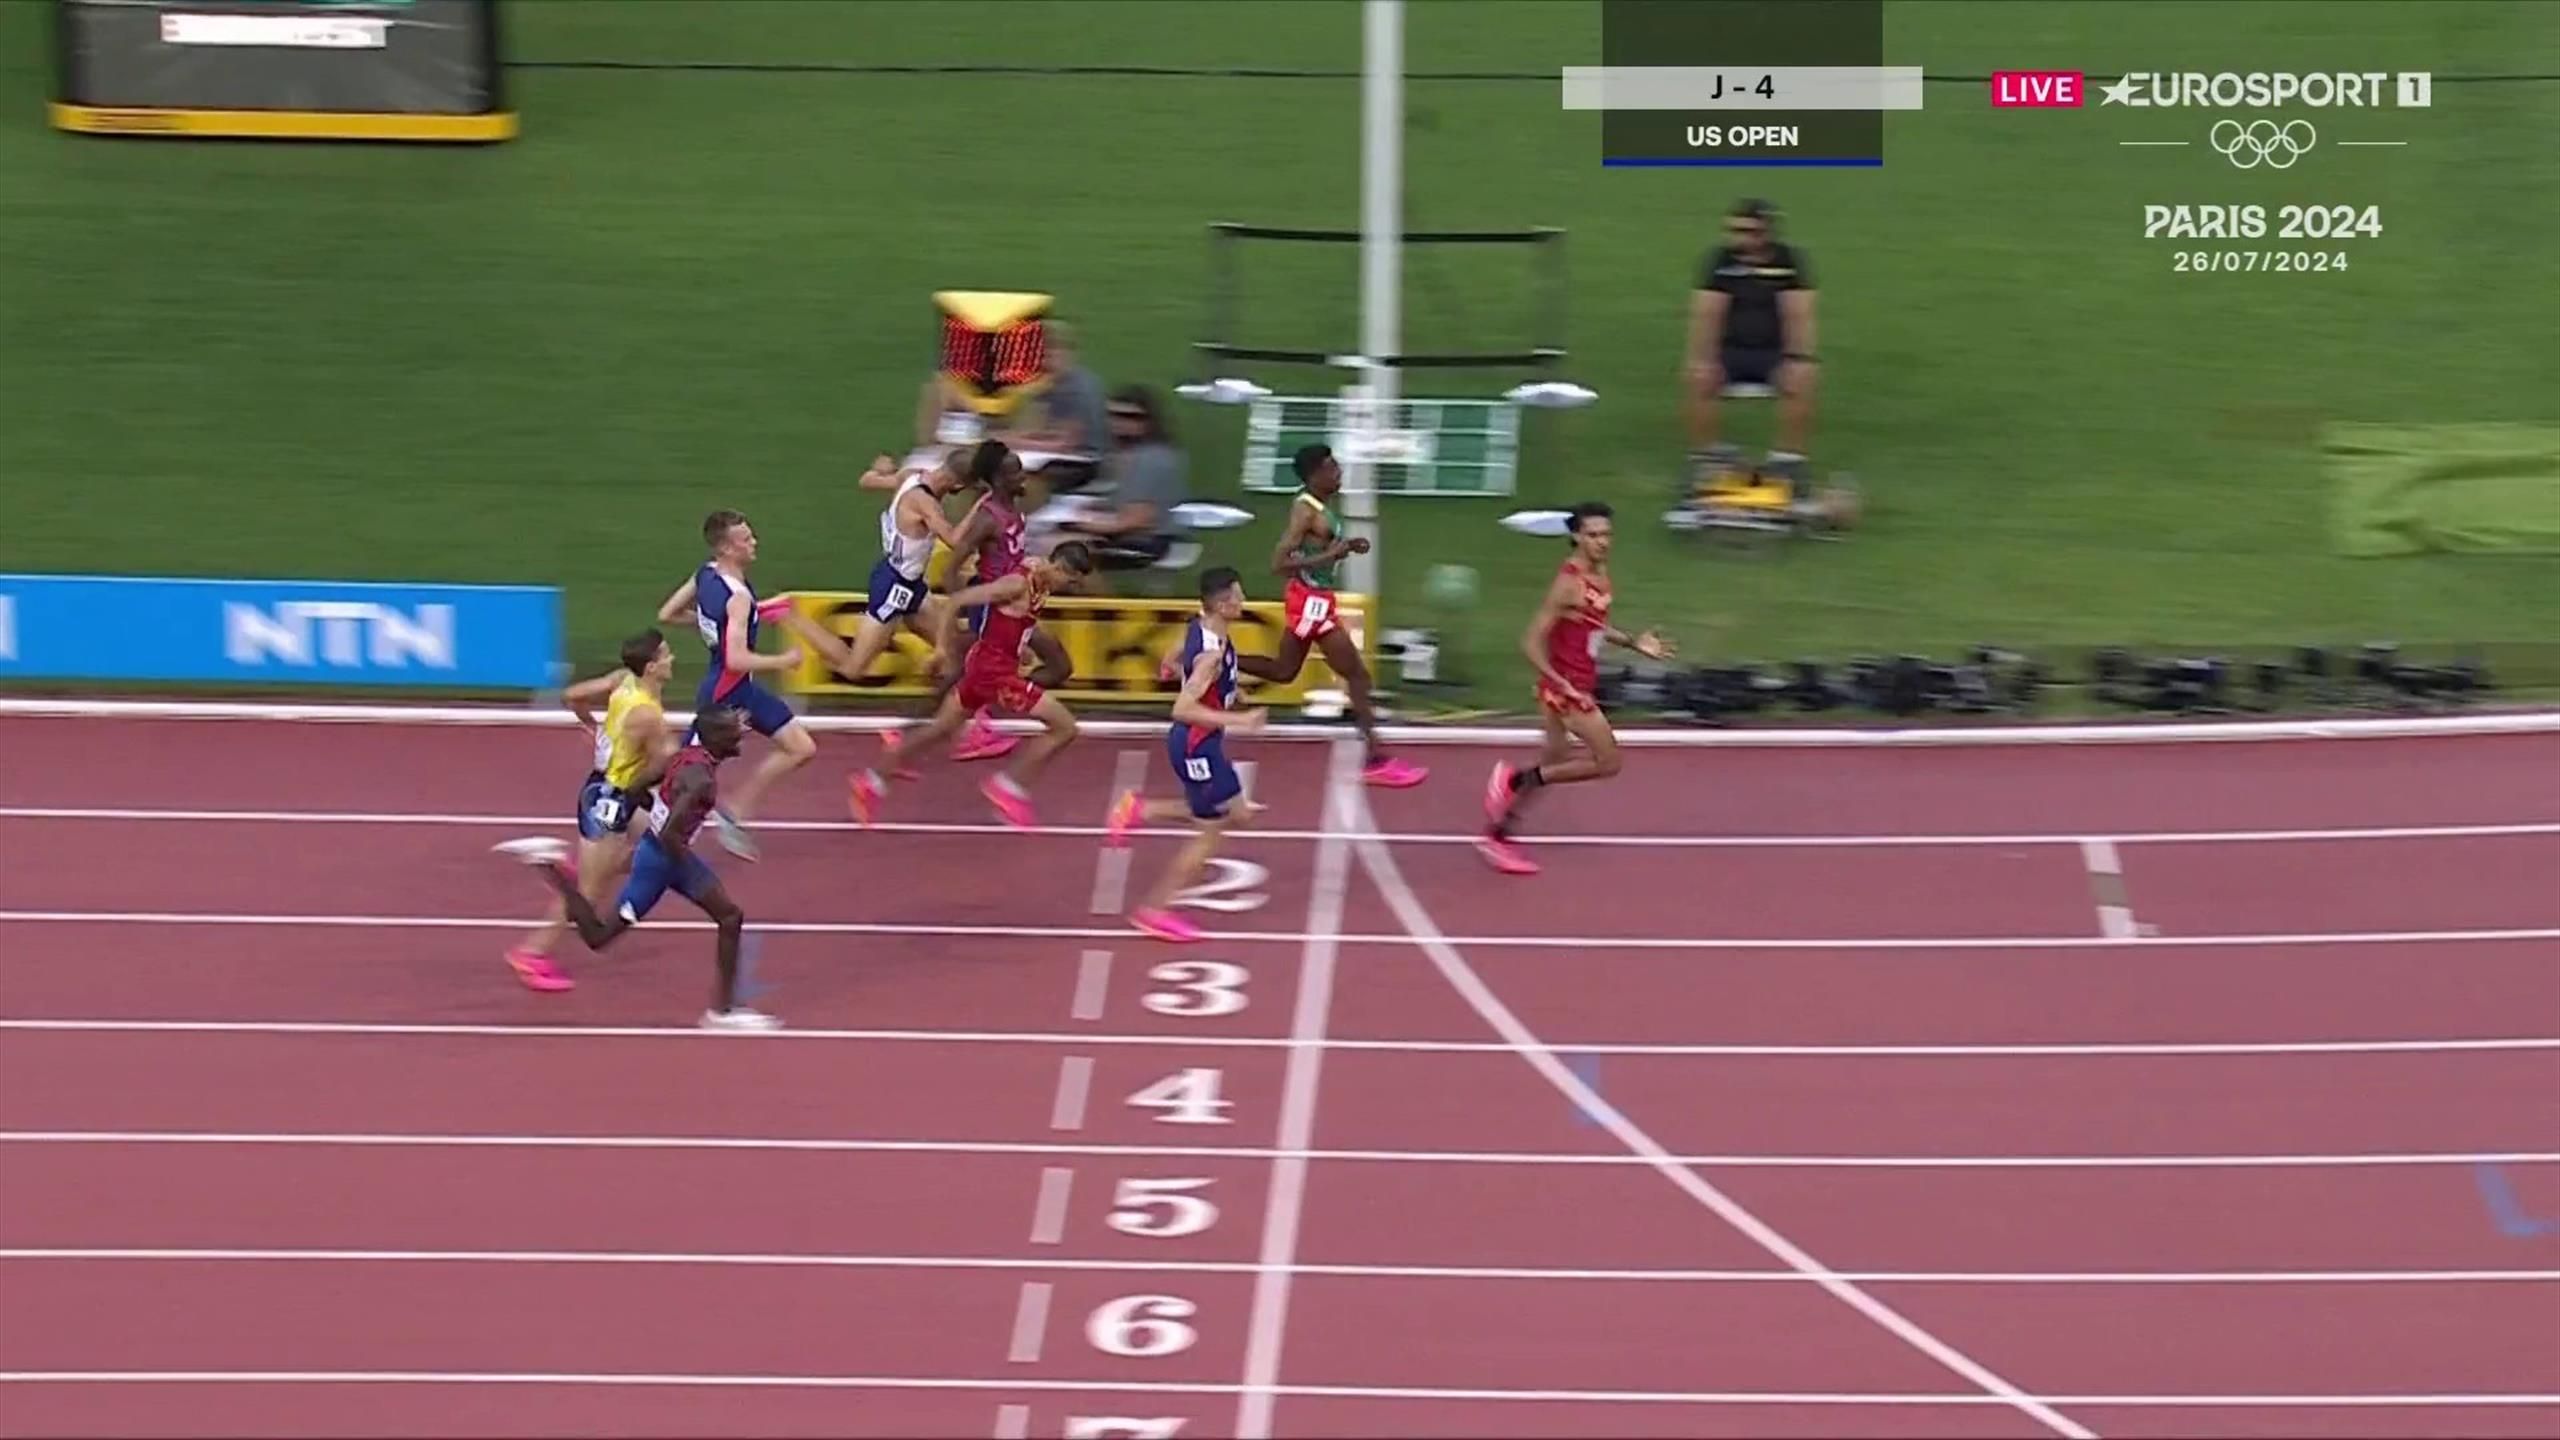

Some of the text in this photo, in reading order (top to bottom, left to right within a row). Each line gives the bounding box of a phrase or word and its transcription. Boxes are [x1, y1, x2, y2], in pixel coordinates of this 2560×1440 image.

[892, 587, 910, 607] 18
[226, 601, 456, 668] NTN
[1170, 857, 1270, 912] 2
[1141, 960, 1249, 1017] 3
[1125, 1067, 1234, 1125] 4
[1106, 1176, 1220, 1238] 5
[1086, 1294, 1199, 1357] 6
